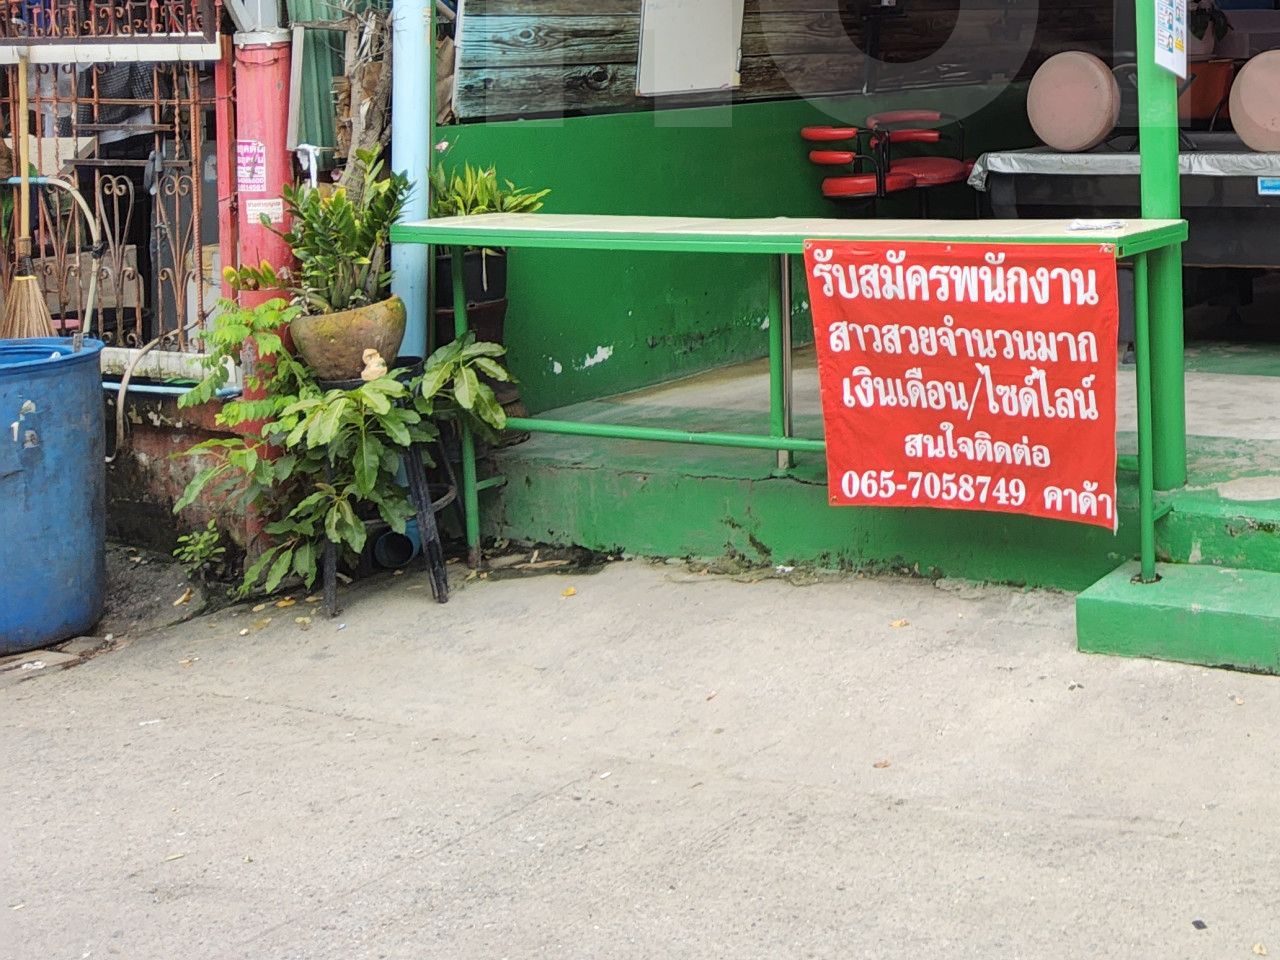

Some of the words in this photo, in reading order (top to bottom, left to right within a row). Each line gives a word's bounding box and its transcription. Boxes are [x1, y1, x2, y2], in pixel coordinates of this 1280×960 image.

[812, 248, 1099, 305] รับสมัครพนักงาน
[828, 314, 1098, 363] สาวสวยจำนวนมาก
[842, 362, 1099, 421] เงินเดือน/ไซด์ไลน์
[904, 422, 1051, 468] สนใจติดต่อ
[841, 469, 1026, 507] 065-7058749
[1043, 480, 1113, 520] คาด้า
